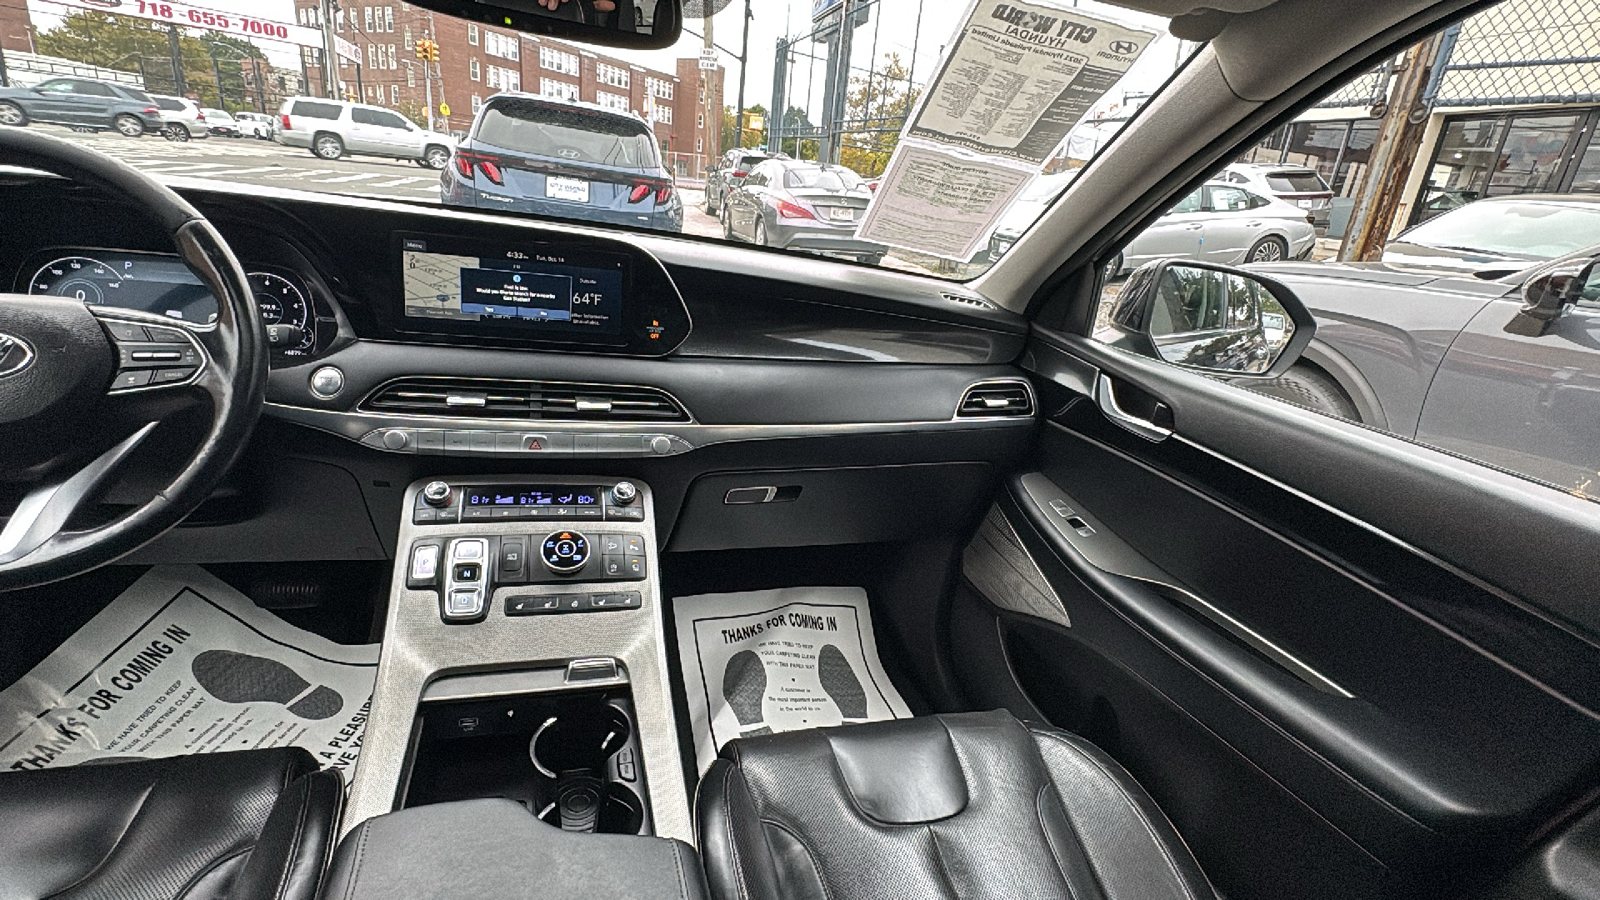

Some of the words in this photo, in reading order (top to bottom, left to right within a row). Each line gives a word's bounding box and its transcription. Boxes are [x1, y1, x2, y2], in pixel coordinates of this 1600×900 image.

[124, 261, 132, 270] P
[572, 292, 603, 306] 64°F
[463, 570, 471, 578] N
[721, 623, 764, 644] THANKS
[766, 614, 787, 629] FOR
[788, 612, 824, 631] COMING
[826, 616, 838, 631] IN
[10, 717, 89, 770] THANKS
[77, 688, 123, 720] FOR
[111, 640, 174, 691] COMING
[162, 624, 191, 645] IN
[117, 722, 139, 740] HAVE
[136, 704, 157, 722] TRIED
[155, 696, 167, 704] TO
[165, 679, 181, 696] KEEP
[140, 706, 177, 738] CARPETING
[175, 686, 197, 706] CLEAN
[328, 695, 373, 749] PLEASUR
